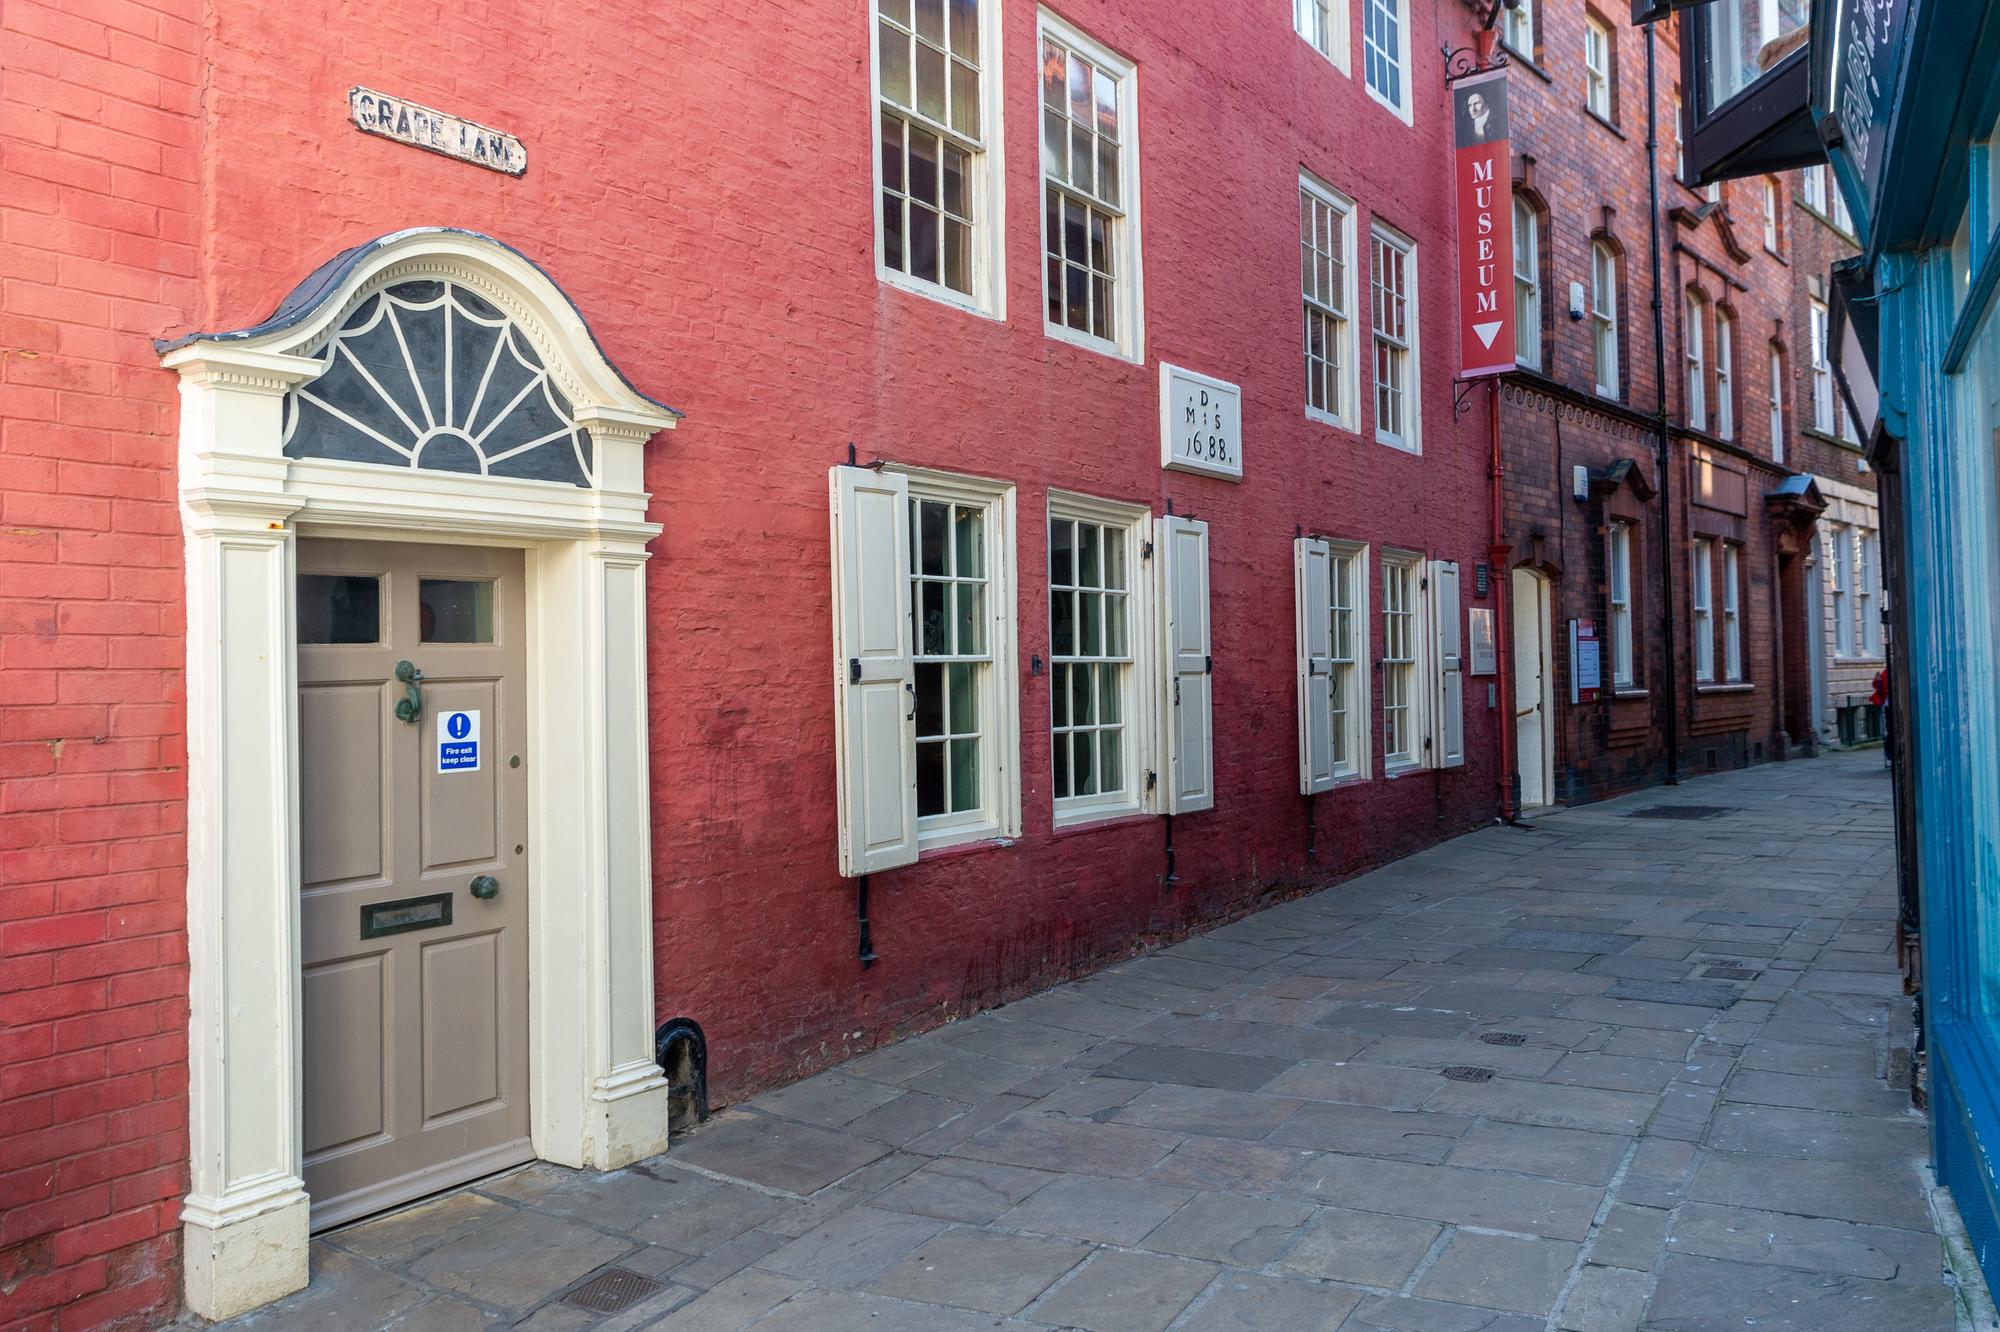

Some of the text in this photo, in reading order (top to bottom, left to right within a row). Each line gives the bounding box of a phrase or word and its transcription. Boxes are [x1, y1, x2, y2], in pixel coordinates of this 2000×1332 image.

[359, 95, 447, 147] GRAPE
[1472, 158, 1498, 315] MUSEUM
[442, 757, 459, 765] keep
